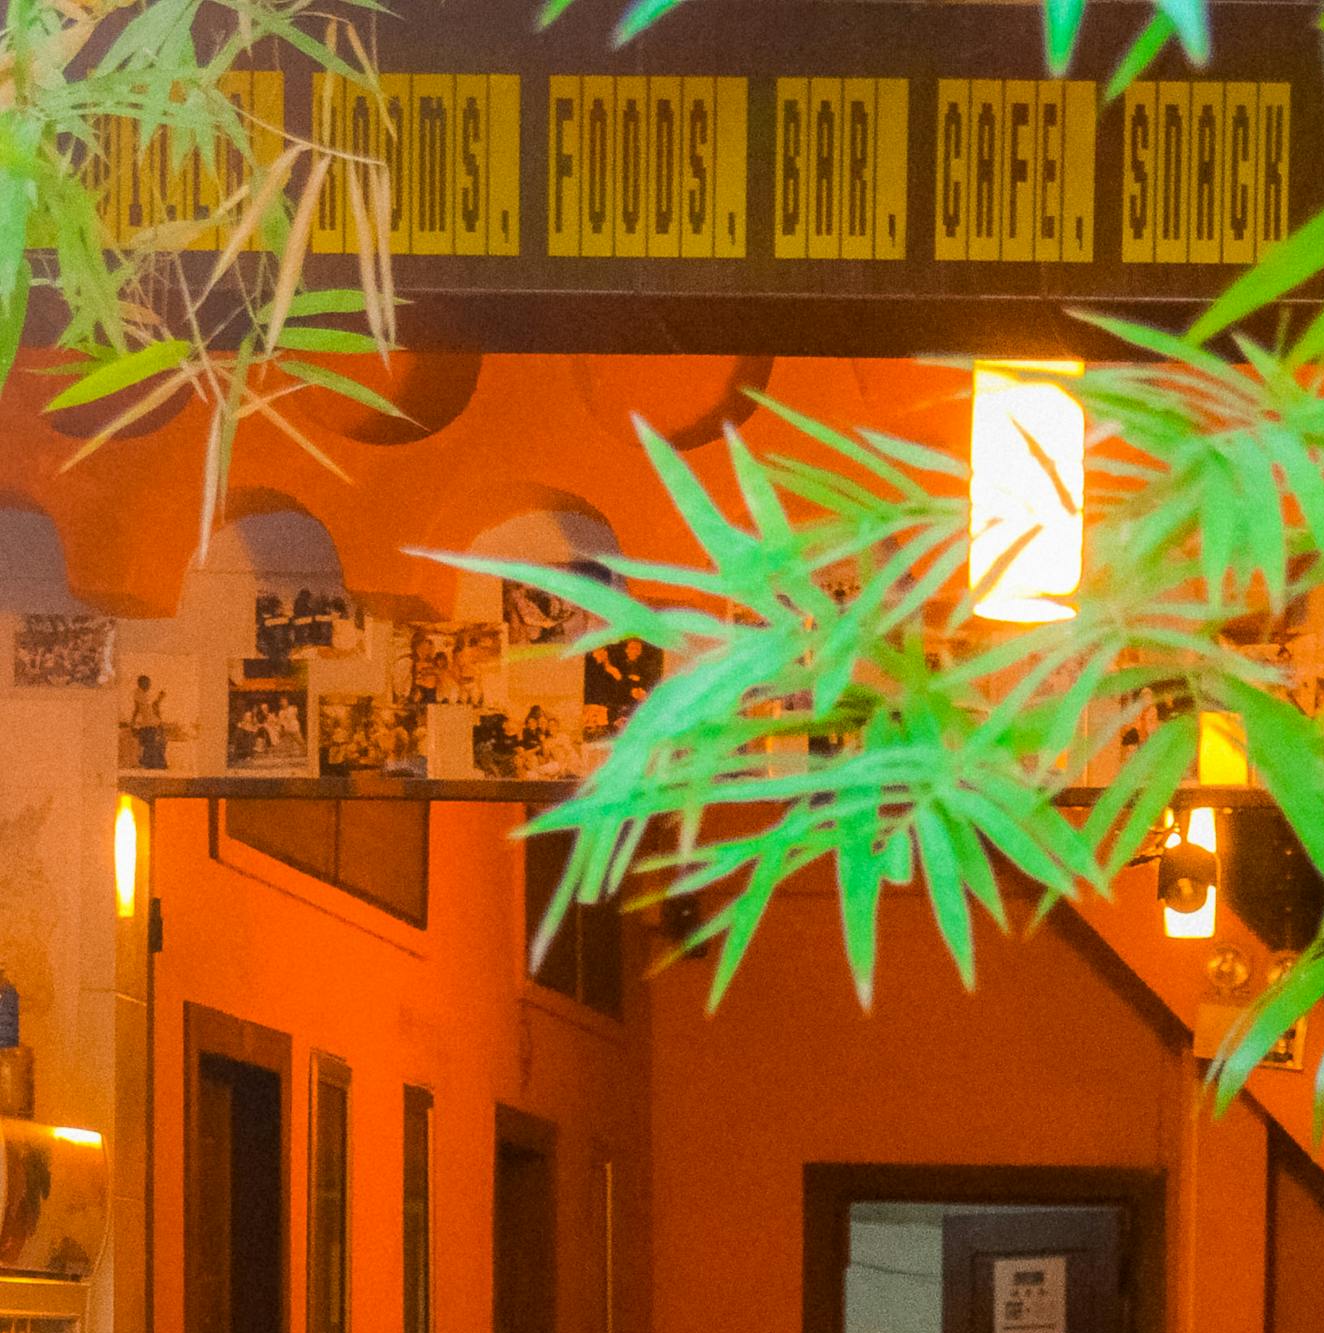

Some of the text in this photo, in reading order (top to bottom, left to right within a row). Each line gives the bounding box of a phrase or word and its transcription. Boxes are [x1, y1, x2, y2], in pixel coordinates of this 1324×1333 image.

[555, 98, 736, 245] FOODS,
[782, 100, 896, 247] BAR,
[942, 102, 1083, 250] CAFE,
[1129, 104, 1284, 241] SNACK
